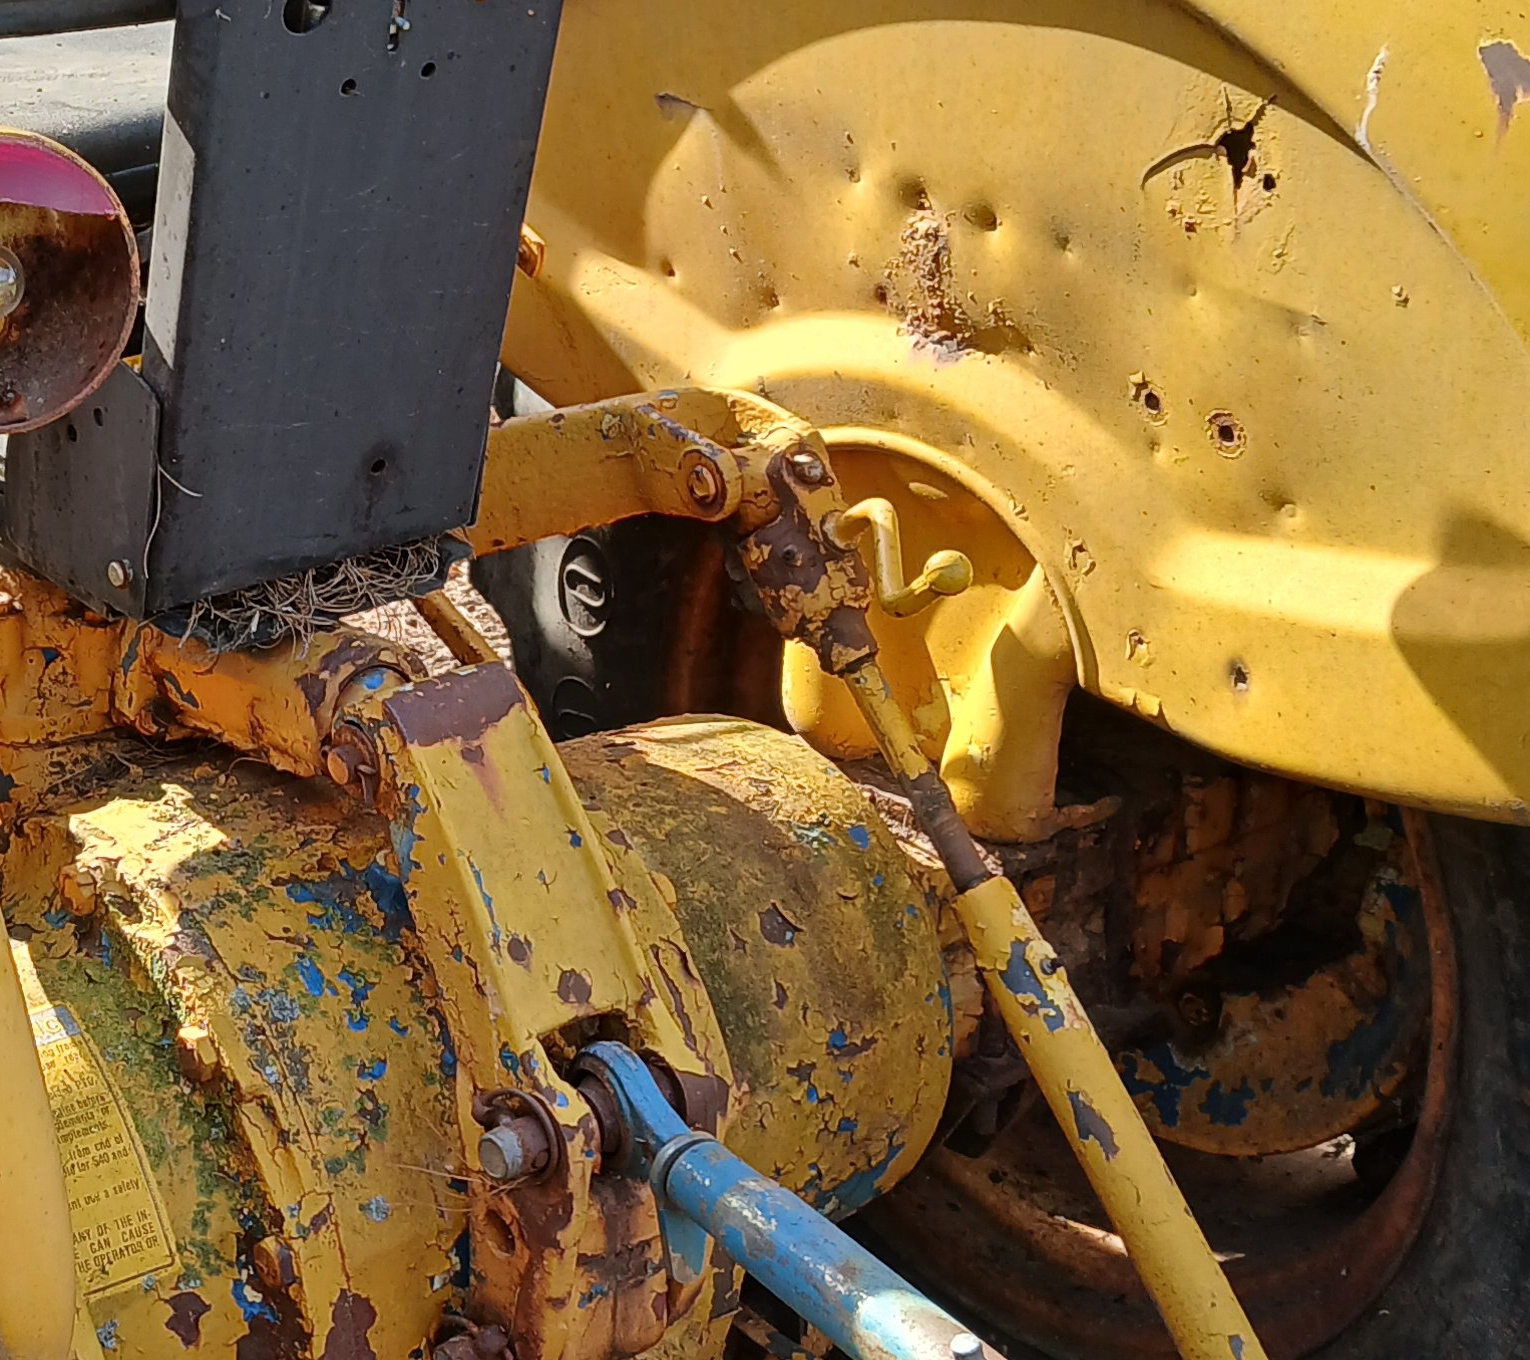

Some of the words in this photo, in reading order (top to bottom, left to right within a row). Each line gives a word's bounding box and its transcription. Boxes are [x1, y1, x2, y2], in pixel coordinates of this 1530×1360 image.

[94, 1138, 111, 1151] end
[92, 1152, 110, 1167] 540
[96, 1223, 110, 1237] OF
[114, 1214, 134, 1230] THE
[121, 1222, 156, 1242] CAUSE
[93, 1241, 144, 1267] OPERATOR
